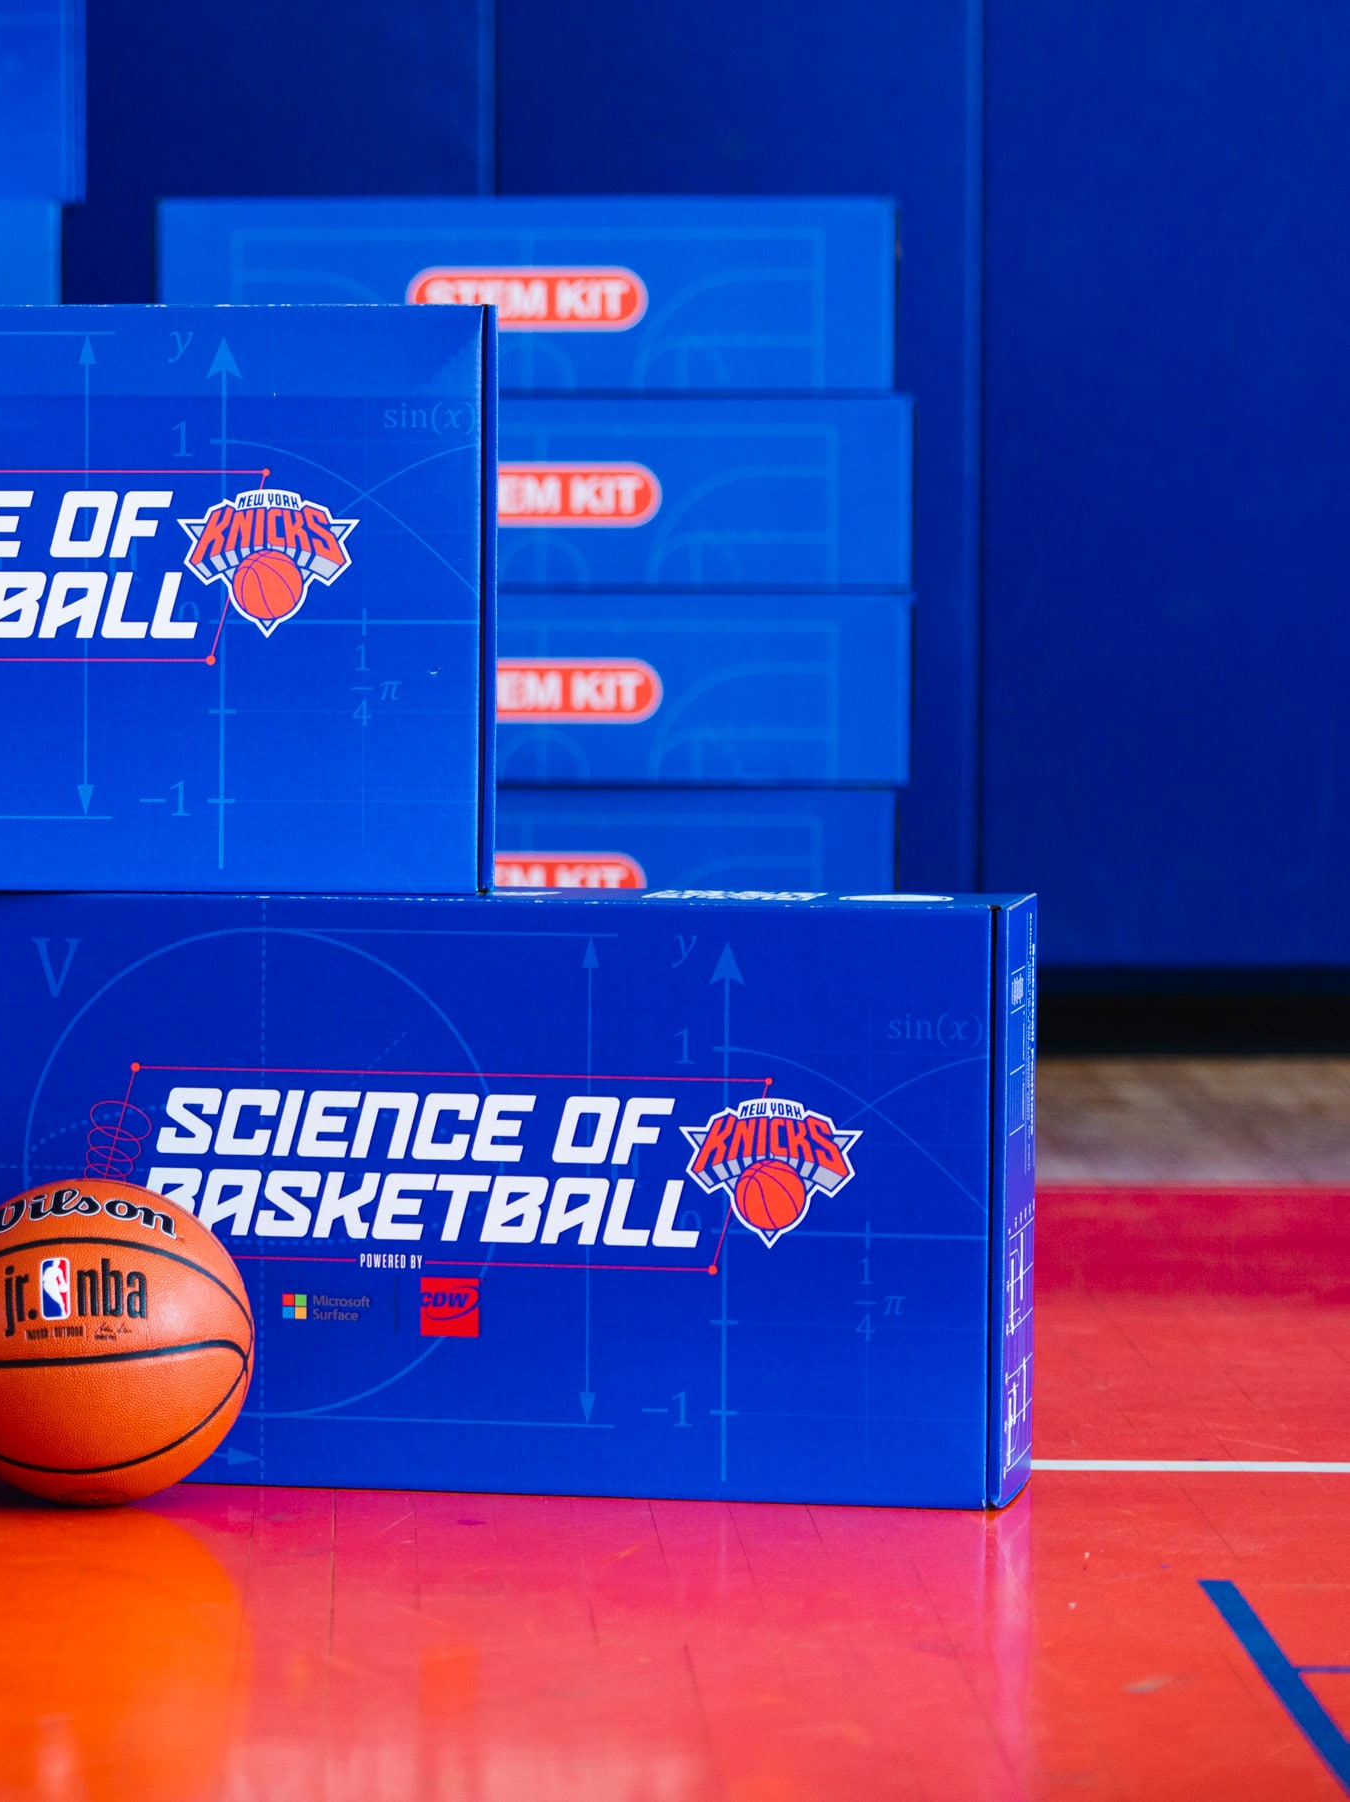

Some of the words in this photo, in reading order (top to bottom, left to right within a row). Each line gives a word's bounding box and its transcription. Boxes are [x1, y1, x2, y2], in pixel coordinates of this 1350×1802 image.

[556, 279, 630, 318] KIT
[168, 332, 194, 362] y
[383, 402, 477, 436] sin(x)
[172, 421, 193, 457] 1
[237, 493, 264, 508] NEW
[267, 493, 300, 509] YORK
[498, 475, 561, 514] EM
[570, 474, 644, 514] KIT
[50, 490, 174, 559] OF
[190, 505, 346, 566] KNICKS
[498, 671, 562, 710] EM
[571, 670, 645, 710] KIT
[672, 933, 698, 966] y
[32, 938, 83, 998] V
[887, 1010, 983, 1045] sin(x)
[674, 1028, 696, 1065] 1
[156, 1087, 537, 1163] SCIENCE
[552, 1096, 676, 1165] OF
[740, 1103, 767, 1117] NEW
[770, 1102, 802, 1119] YORK
[692, 1114, 849, 1178] KNICKS
[145, 1167, 700, 1248] BASKETBALL
[359, 1253, 407, 1269] POWERED
[410, 1254, 423, 1270] BY
[4, 1265, 38, 1337] jr.
[77, 1258, 147, 1318] nba
[313, 1295, 370, 1308] Microsoft
[313, 1308, 359, 1321] Surface
[421, 1292, 470, 1308] CDW
